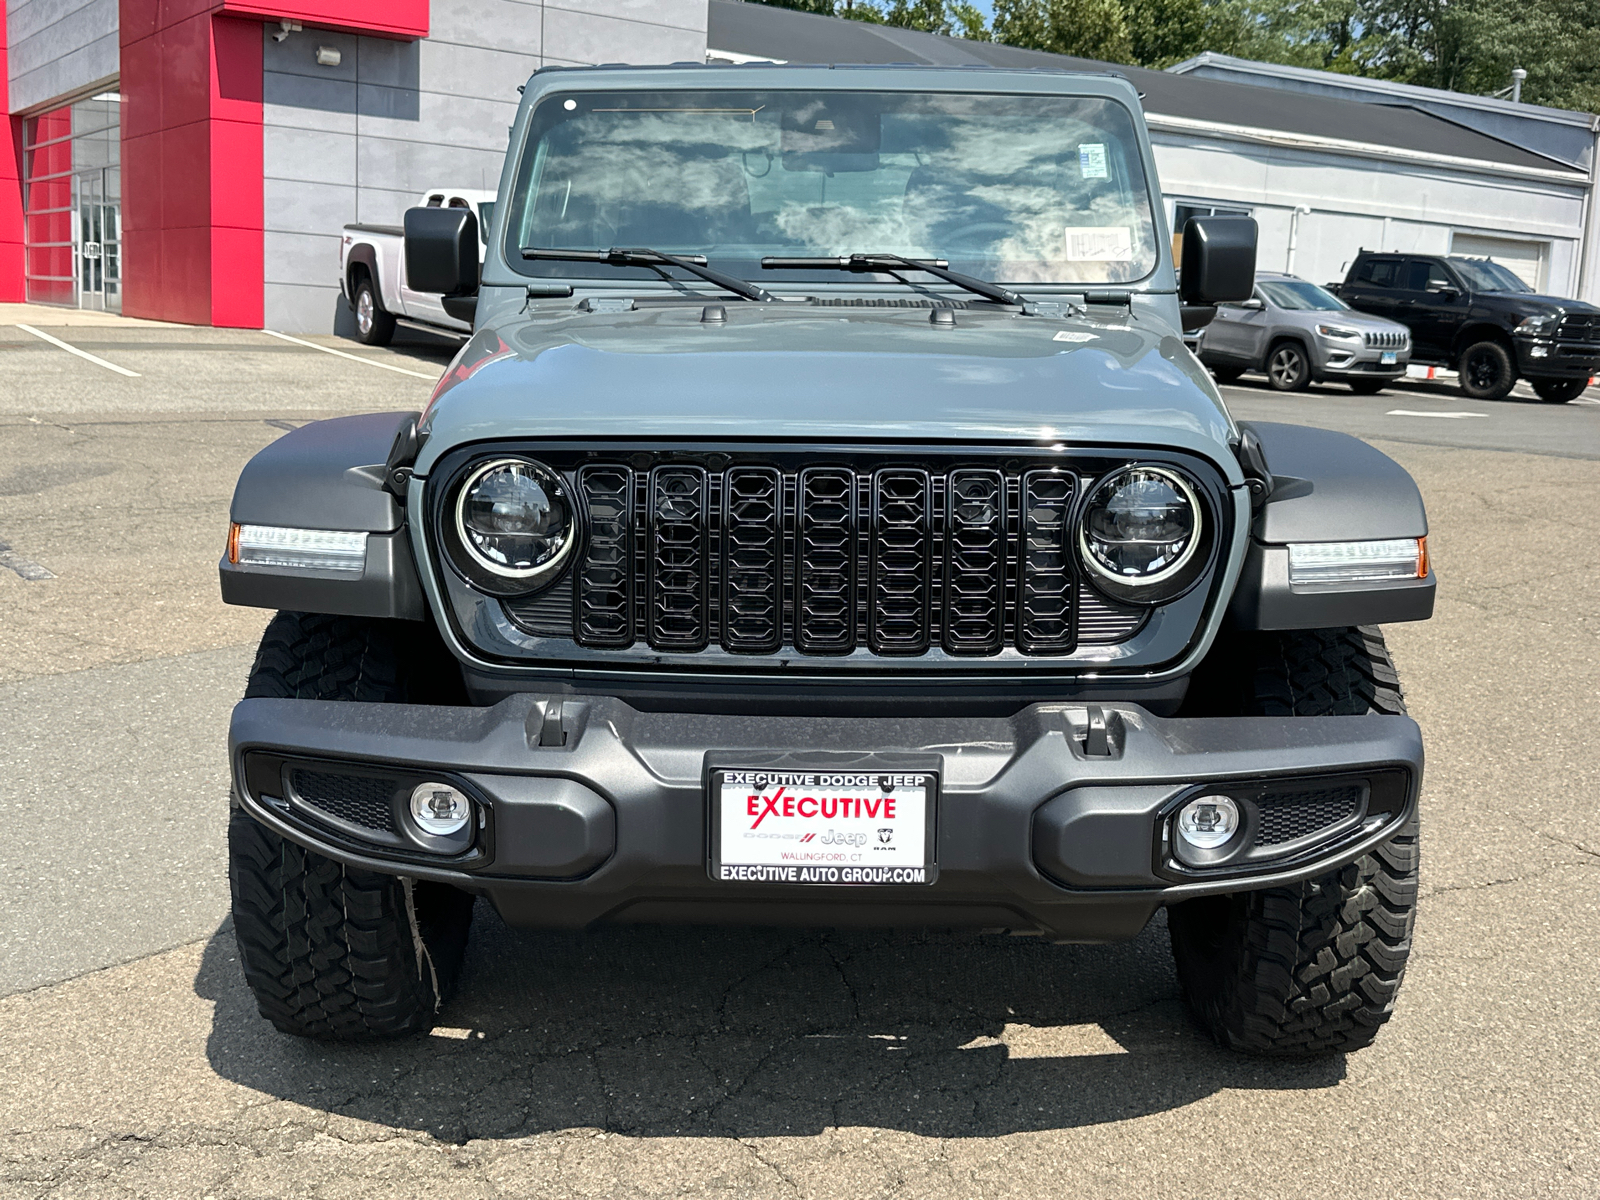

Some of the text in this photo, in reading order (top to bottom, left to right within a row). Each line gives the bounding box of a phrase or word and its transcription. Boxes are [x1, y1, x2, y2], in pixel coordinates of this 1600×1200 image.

[723, 773, 925, 787] EXECUTIVE DODGE JEEP
[747, 787, 896, 829] EXECUTIVE
[821, 829, 867, 848] Jeep
[781, 852, 862, 862] WALLINGFORD, CT
[720, 866, 925, 883] EXECUTIVE AUTO GROUP.COM
